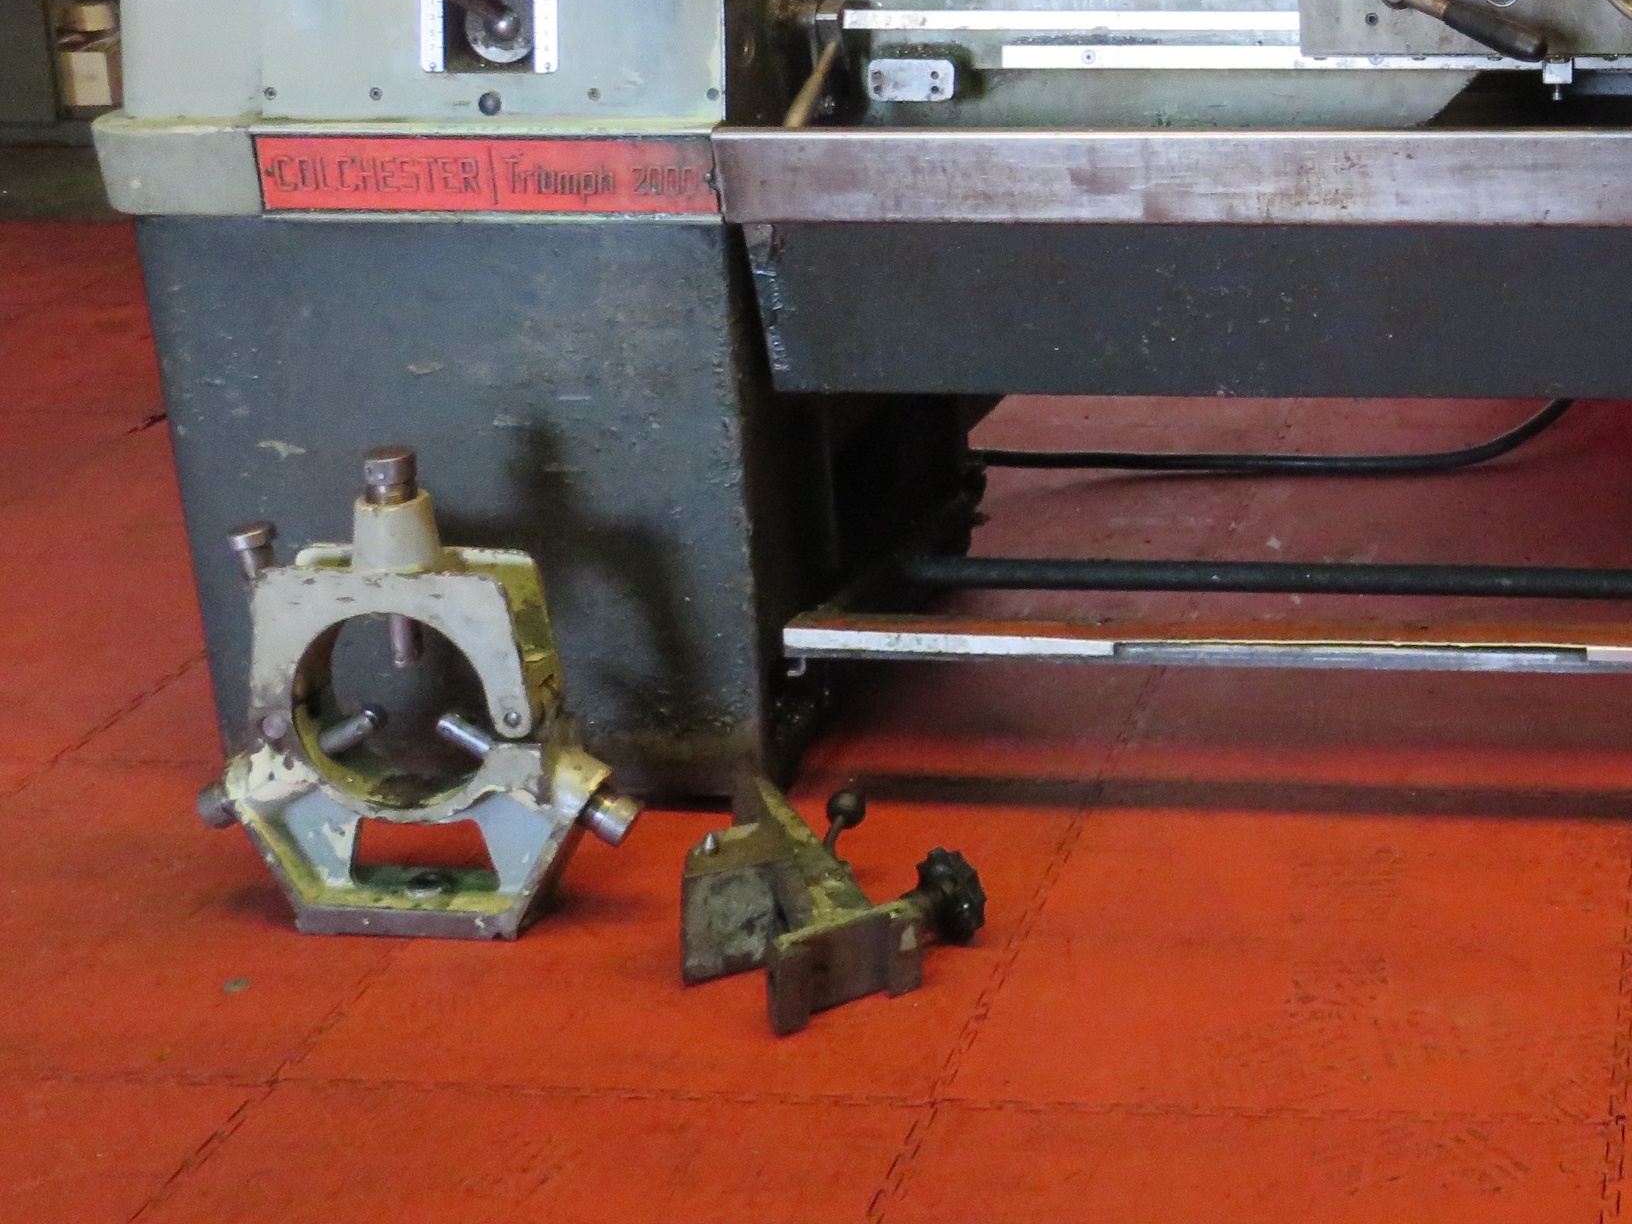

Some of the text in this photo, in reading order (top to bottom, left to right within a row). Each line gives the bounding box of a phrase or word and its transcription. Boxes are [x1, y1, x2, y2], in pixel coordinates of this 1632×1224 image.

[273, 153, 699, 205] COLCHESTER Triumph 2000
